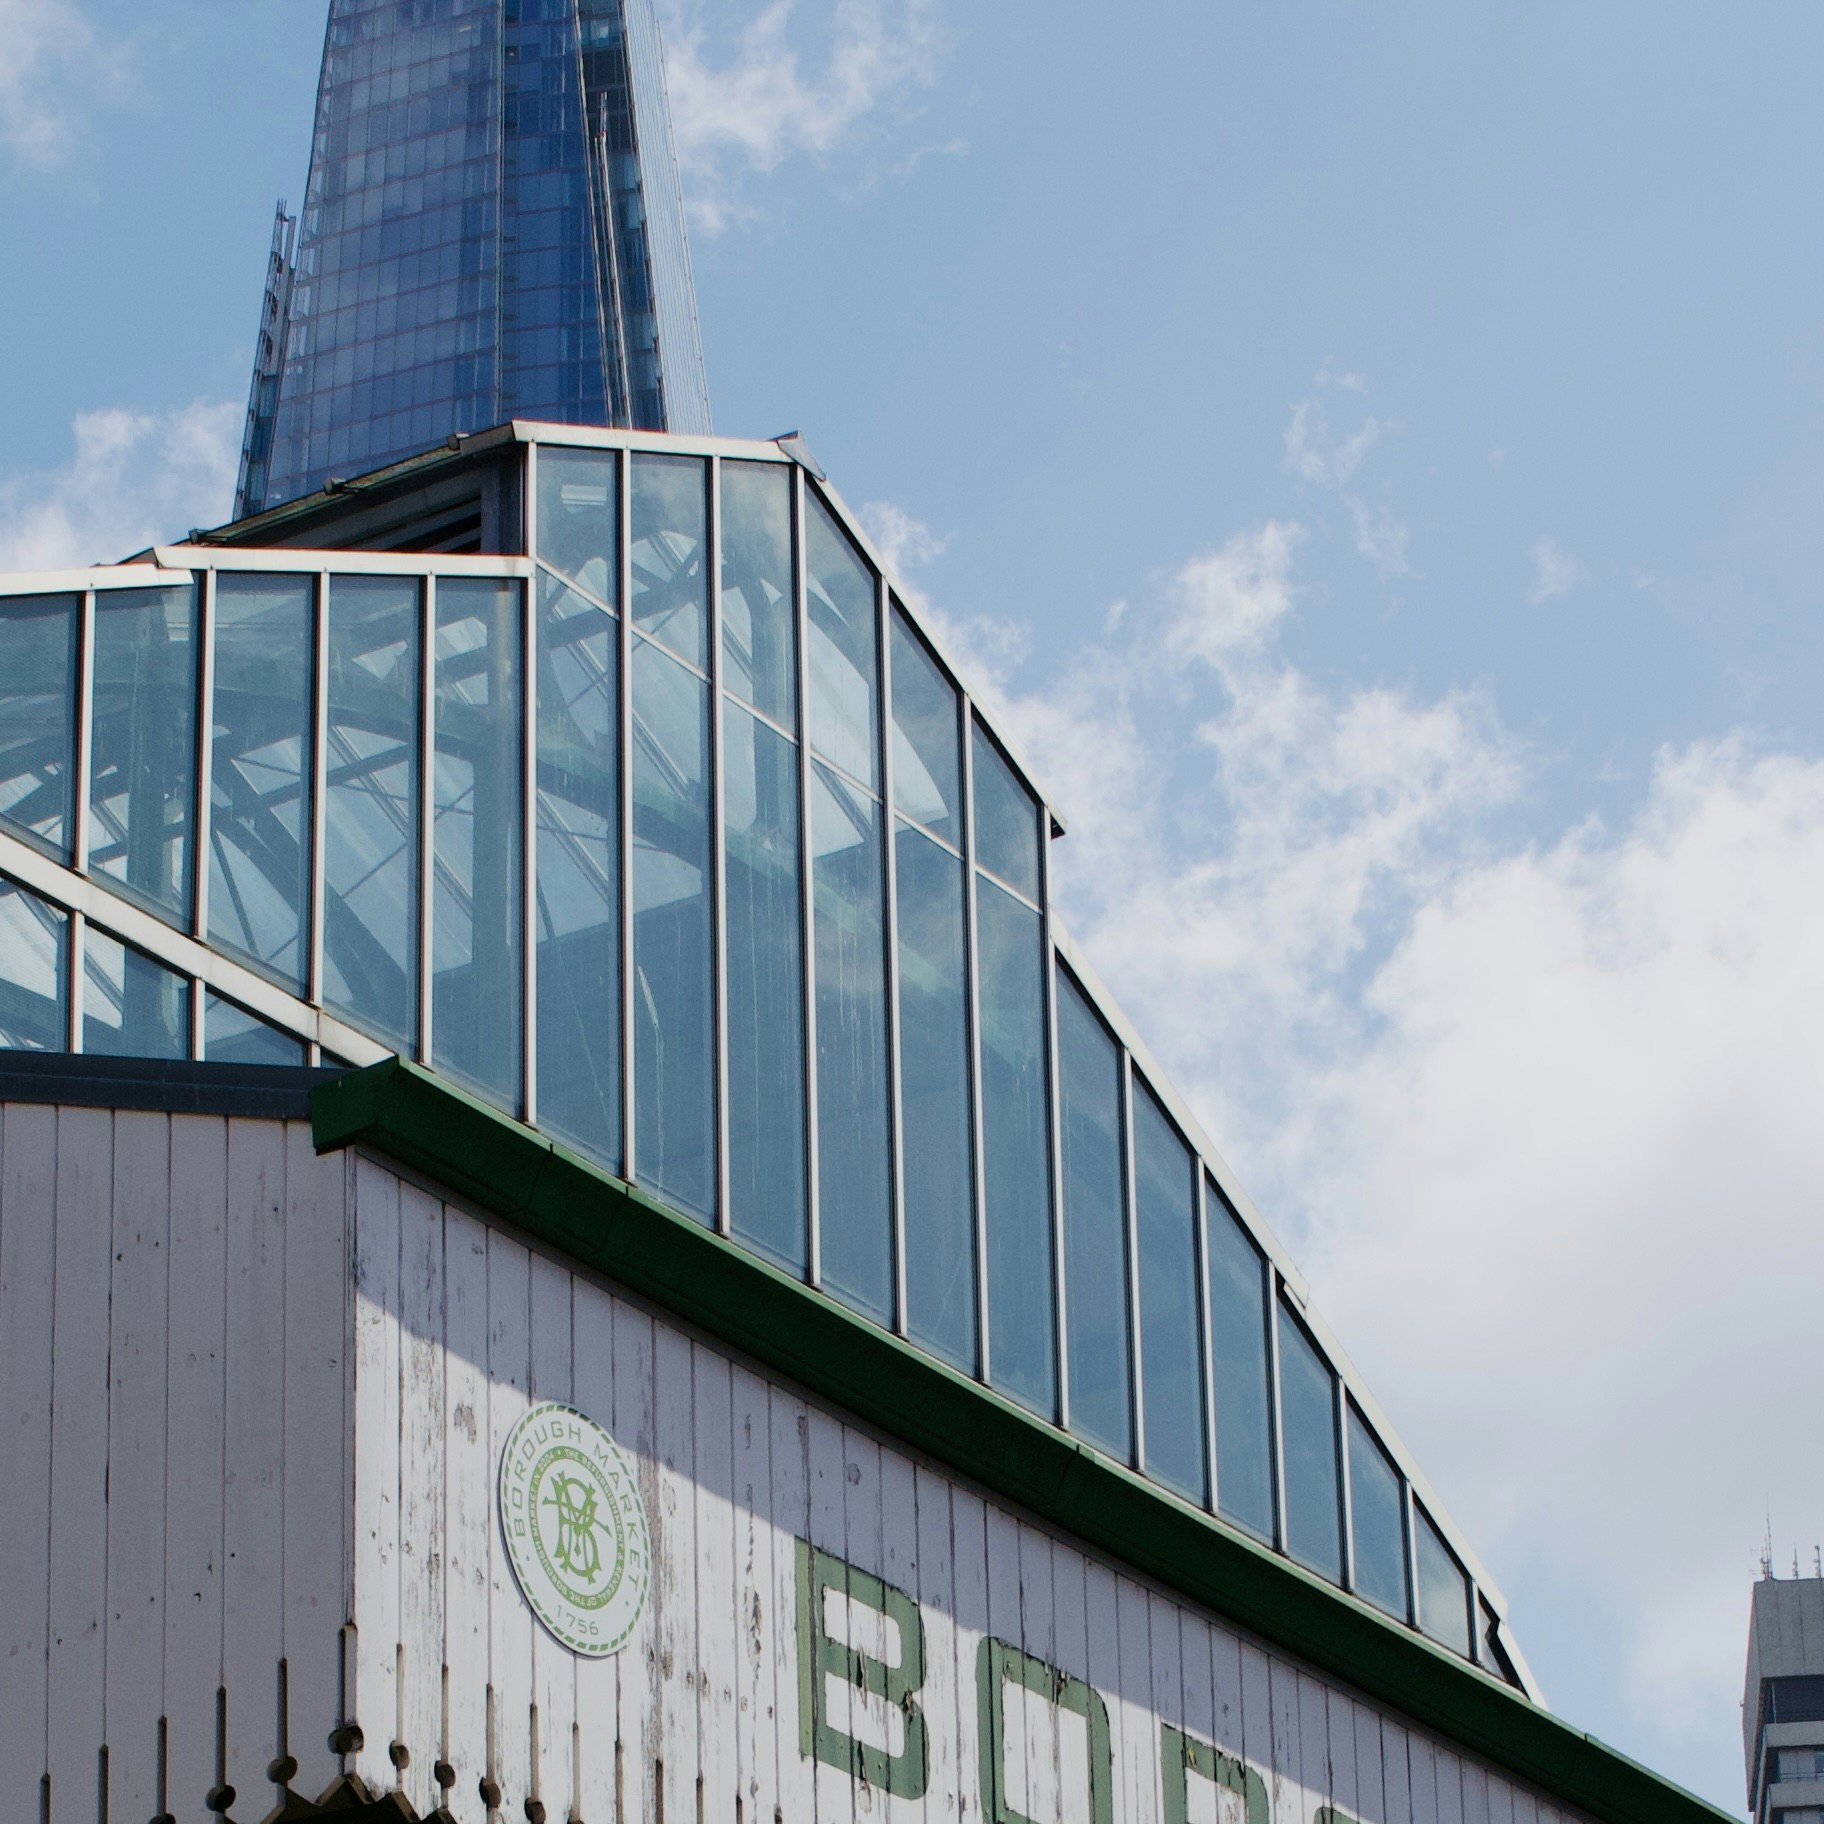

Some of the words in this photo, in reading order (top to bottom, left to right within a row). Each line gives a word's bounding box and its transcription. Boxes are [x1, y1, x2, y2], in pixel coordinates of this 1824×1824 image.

[512, 1420, 581, 1537] BOROUGH
[594, 1443, 641, 1592] MARKET
[530, 1485, 539, 1537] MARKET
[535, 1539, 567, 1597] BOROUGH
[556, 1604, 599, 1636] 1756
